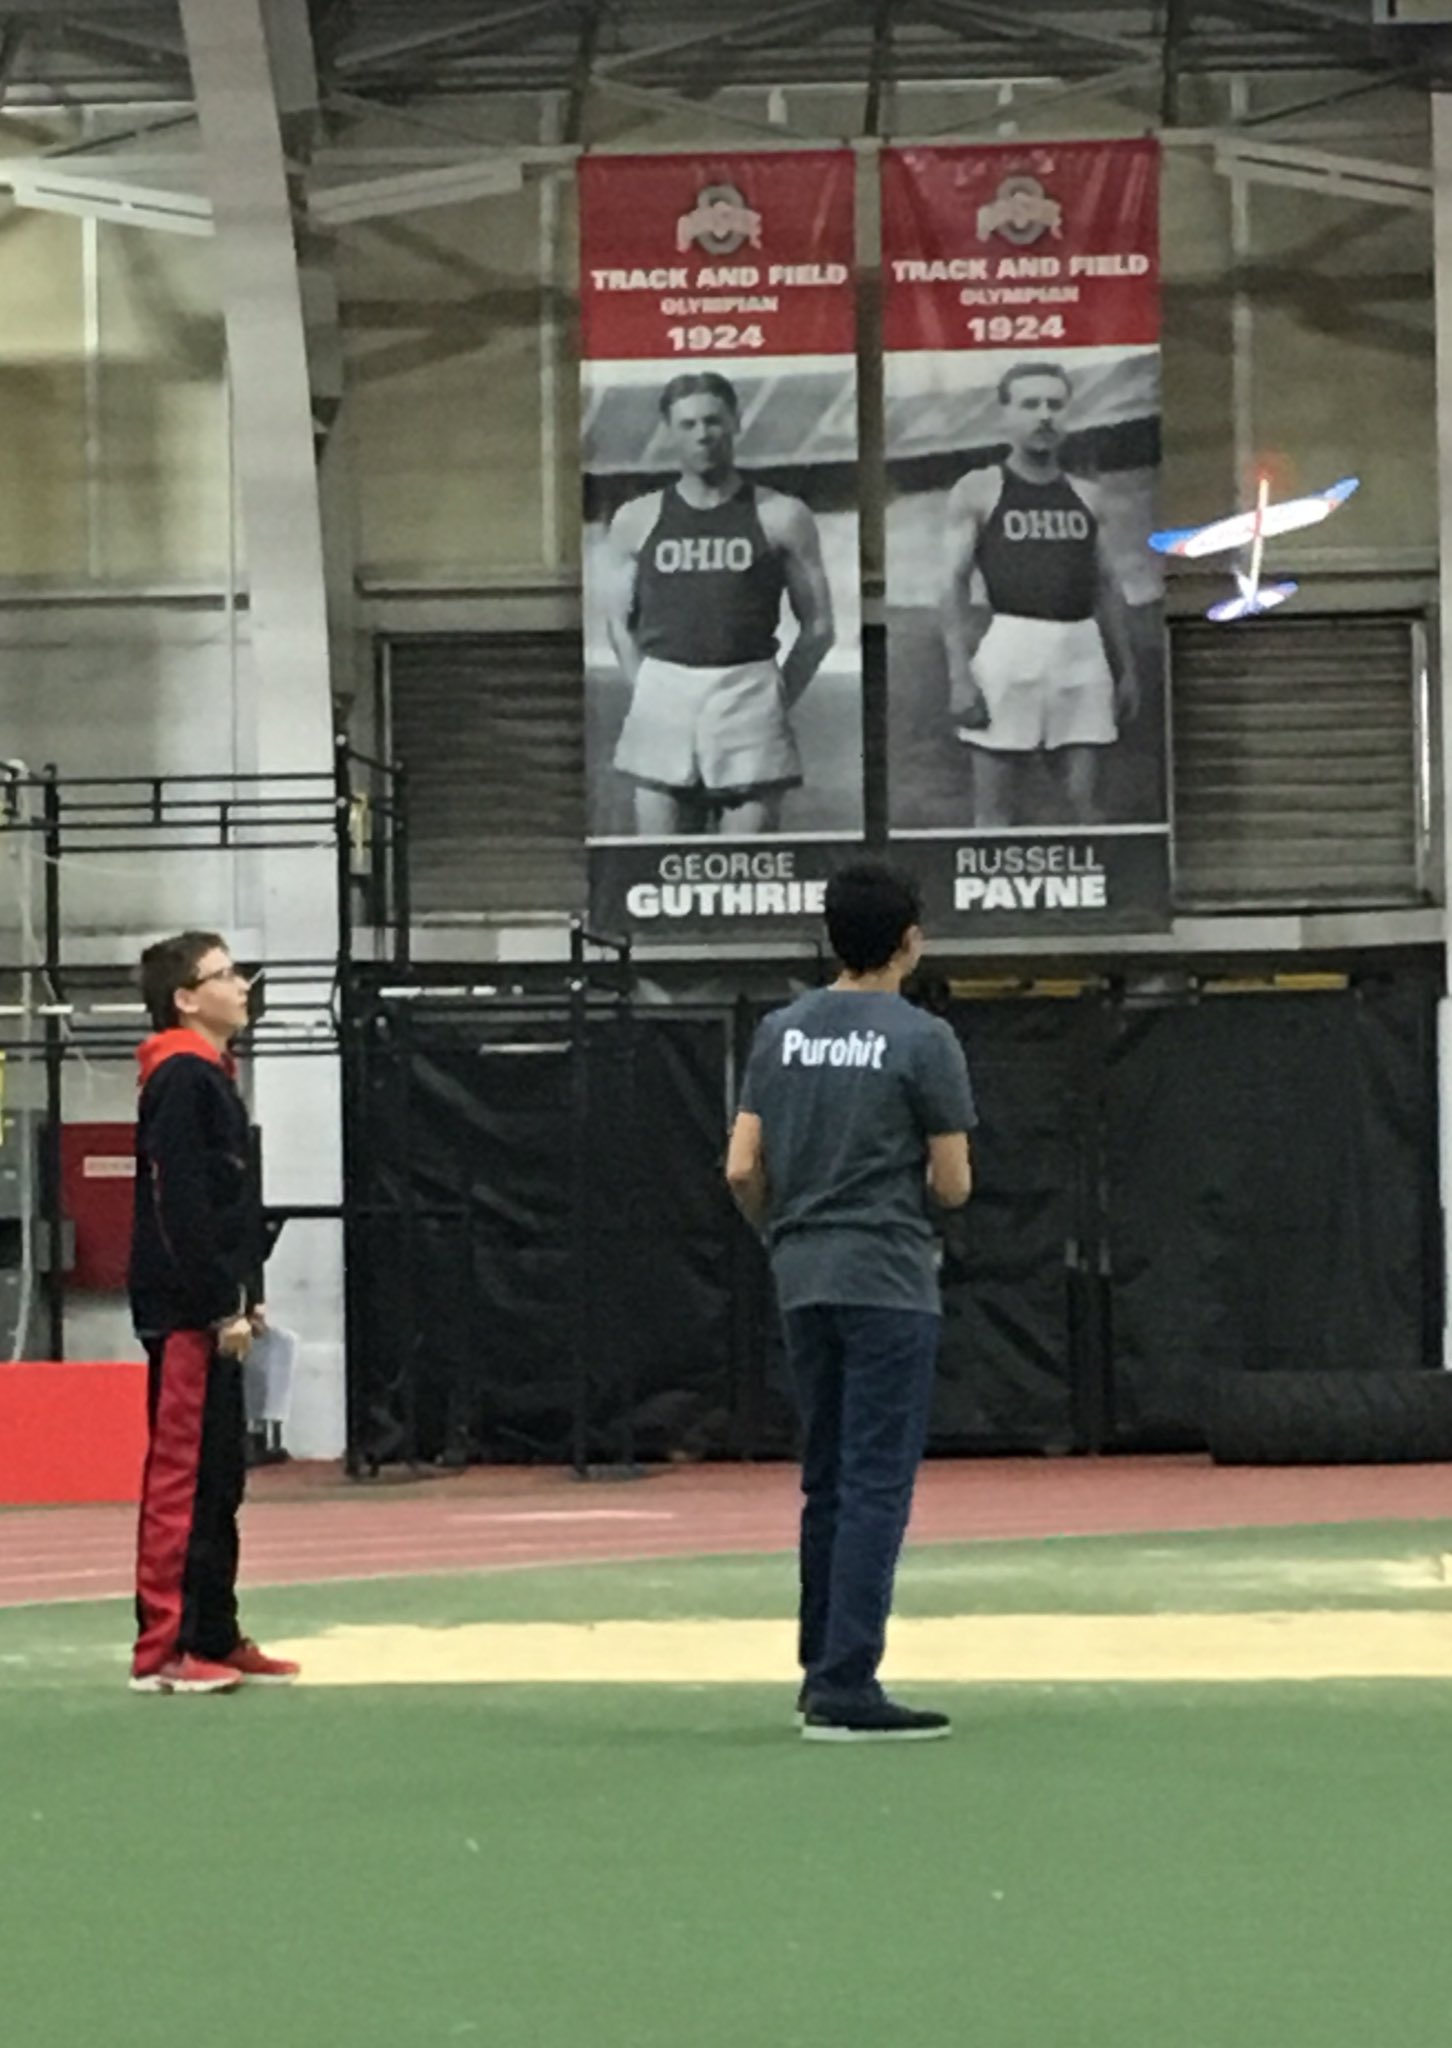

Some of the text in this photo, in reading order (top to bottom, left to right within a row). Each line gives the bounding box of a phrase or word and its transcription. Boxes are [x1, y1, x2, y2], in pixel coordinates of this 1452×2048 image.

[590, 264, 848, 291] TRACK AND FIELD
[892, 254, 1149, 282] TRACK AND FIELD
[660, 296, 779, 315] OLYMPIAN
[959, 286, 1080, 306] OLYMPIAN
[667, 325, 766, 351] 1924
[967, 314, 1066, 342] 1924
[1003, 509, 1089, 541] OHIO
[655, 537, 753, 573] OHIO
[659, 851, 796, 881] GEORGE
[955, 845, 1105, 875] RUSSELL
[626, 880, 828, 918] GUTHRIE
[954, 874, 1107, 910] PAYNE
[782, 1028, 887, 1069] Purohit
